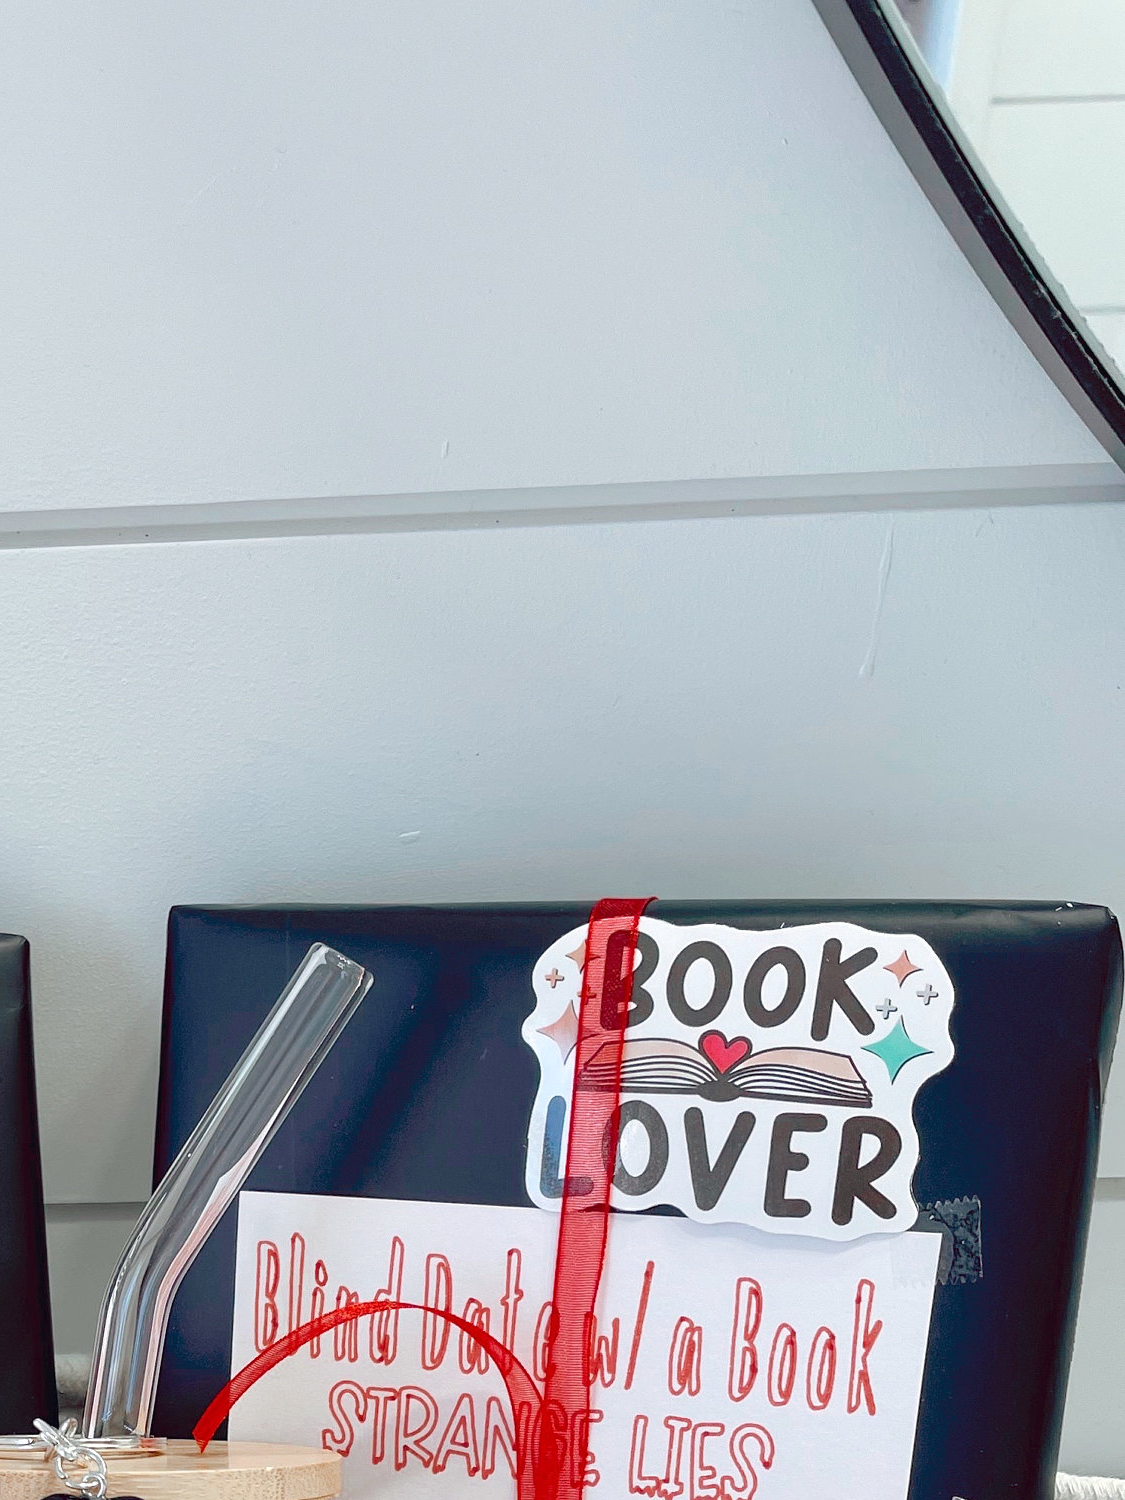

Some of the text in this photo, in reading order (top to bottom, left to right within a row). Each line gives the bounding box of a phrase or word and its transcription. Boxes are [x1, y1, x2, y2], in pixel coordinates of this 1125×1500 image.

[600, 930, 878, 1041] BOOK
[540, 1095, 902, 1226] LOVER
[254, 1232, 405, 1367] Blind
[423, 1247, 558, 1384] Date
[668, 1316, 704, 1396] a
[728, 1275, 884, 1416] Book
